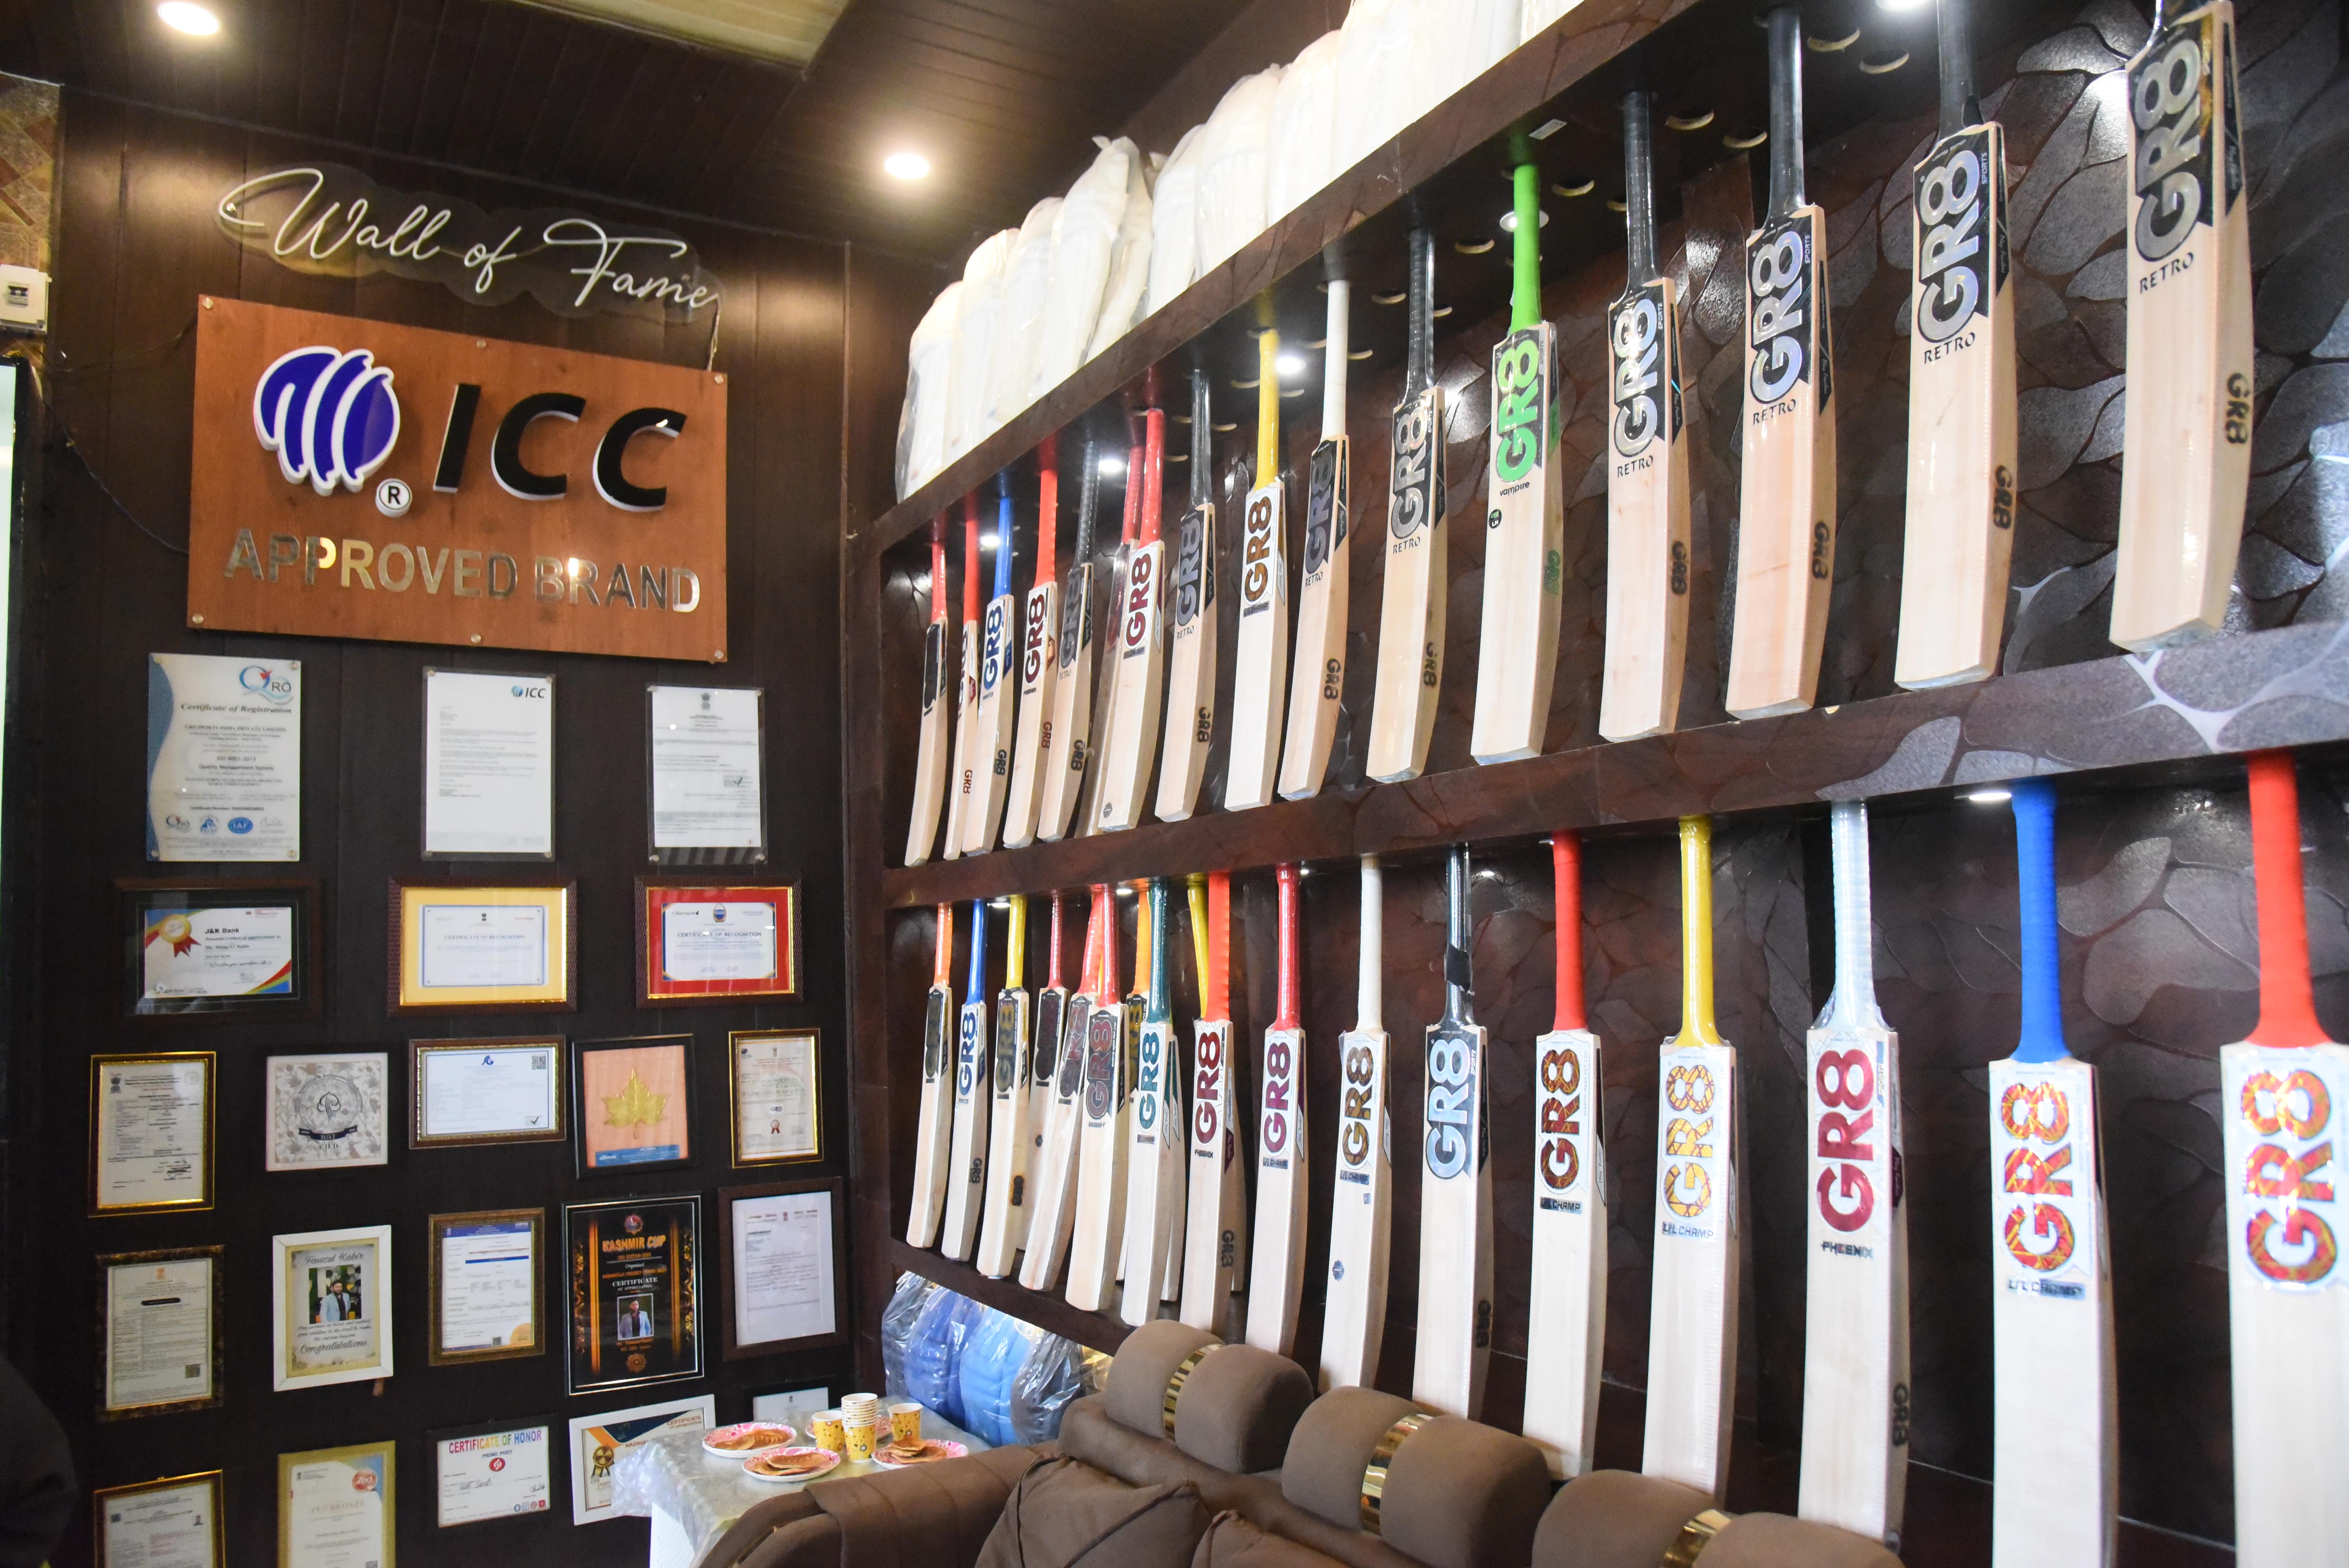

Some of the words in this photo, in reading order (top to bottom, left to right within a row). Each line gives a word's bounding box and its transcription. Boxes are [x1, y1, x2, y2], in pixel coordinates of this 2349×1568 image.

[2135, 38, 2201, 261] GR8
[219, 168, 451, 260] Wall
[462, 225, 523, 294] of
[543, 218, 722, 308] Fame
[1917, 150, 1980, 344] GR8
[2139, 251, 2195, 295] RETRO
[1750, 231, 1803, 404] GR8
[1923, 330, 1976, 365] RETRO
[1614, 298, 1658, 458] GR8
[1496, 339, 1540, 485] GR8
[1752, 398, 1796, 426] RETRO
[2226, 371, 2250, 446] GR8
[433, 383, 687, 513] ICC
[1616, 454, 1654, 480] RETRO
[1391, 406, 1427, 540] GR8
[1499, 481, 1530, 498] vampire
[1305, 449, 1333, 575] GR8
[1490, 510, 1500, 519] GR8
[1993, 464, 2014, 532] GR8
[1393, 536, 1421, 555] RETRO
[1491, 519, 1499, 528] LH
[223, 527, 519, 599] APPROVED
[535, 557, 701, 614] BRAND
[1176, 517, 1201, 627] GR8
[1244, 496, 1272, 602] GR8
[1543, 549, 1560, 597] GR8
[1671, 540, 1688, 596] GR8
[1812, 520, 1830, 581] GR8
[1126, 553, 1152, 647] GR8
[1305, 571, 1323, 588] RETRO
[1025, 593, 1045, 684] GR8
[1059, 573, 1082, 669] GR8
[1176, 625, 1195, 640] RETRO
[983, 605, 1002, 690] GR8
[1423, 642, 1440, 688] GR8
[525, 687, 545, 698] ICC
[1059, 668, 1072, 680] RETRO
[1323, 657, 1341, 700] GR8
[1041, 721, 1053, 749] GR8
[1196, 706, 1212, 743] GR8
[995, 748, 1007, 776] GR8
[1071, 738, 1085, 772] GR8
[963, 770, 973, 795] GR8
[959, 1012, 976, 1096] GR8
[995, 1003, 1014, 1092] GR8
[1085, 1019, 1113, 1120] GR8
[1139, 1032, 1160, 1129] GR8
[1195, 1031, 1221, 1144] GR8
[1264, 1041, 1291, 1154] GR8
[1342, 1046, 1374, 1167] GR8
[1426, 1038, 1471, 1180] GR8
[1541, 1048, 1580, 1190] GR8
[1194, 1149, 1214, 1159] PHOENIX
[1269, 1158, 1287, 1167] CHAMP
[1665, 1064, 1715, 1217] GR8
[1816, 1048, 1874, 1233] GR8
[974, 1157, 983, 1184] GR8
[1348, 1172, 1369, 1184] CHAMP
[2001, 1082, 2075, 1272] GR8
[2241, 1068, 2338, 1285] GR8
[1552, 1197, 1581, 1211] CHAMP
[602, 1237, 645, 1253] KASHMIR
[646, 1235, 667, 1249] CUP
[1221, 1228, 1234, 1268] GR8
[1678, 1225, 1714, 1239] CHAMP
[1820, 1240, 1873, 1258] PHOENIX
[612, 1276, 658, 1287] CERTIFICATE
[2031, 1279, 2083, 1297] CHAMP
[300, 1340, 368, 1355] Congratulations
[667, 1415, 701, 1425] CERTIFICATE
[1892, 1382, 1909, 1448] GR8
[449, 1435, 499, 1454] CERTIFICATE
[502, 1434, 512, 1445] OF
[514, 1429, 542, 1445] HONOR
[357, 1475, 372, 1484] Zed
